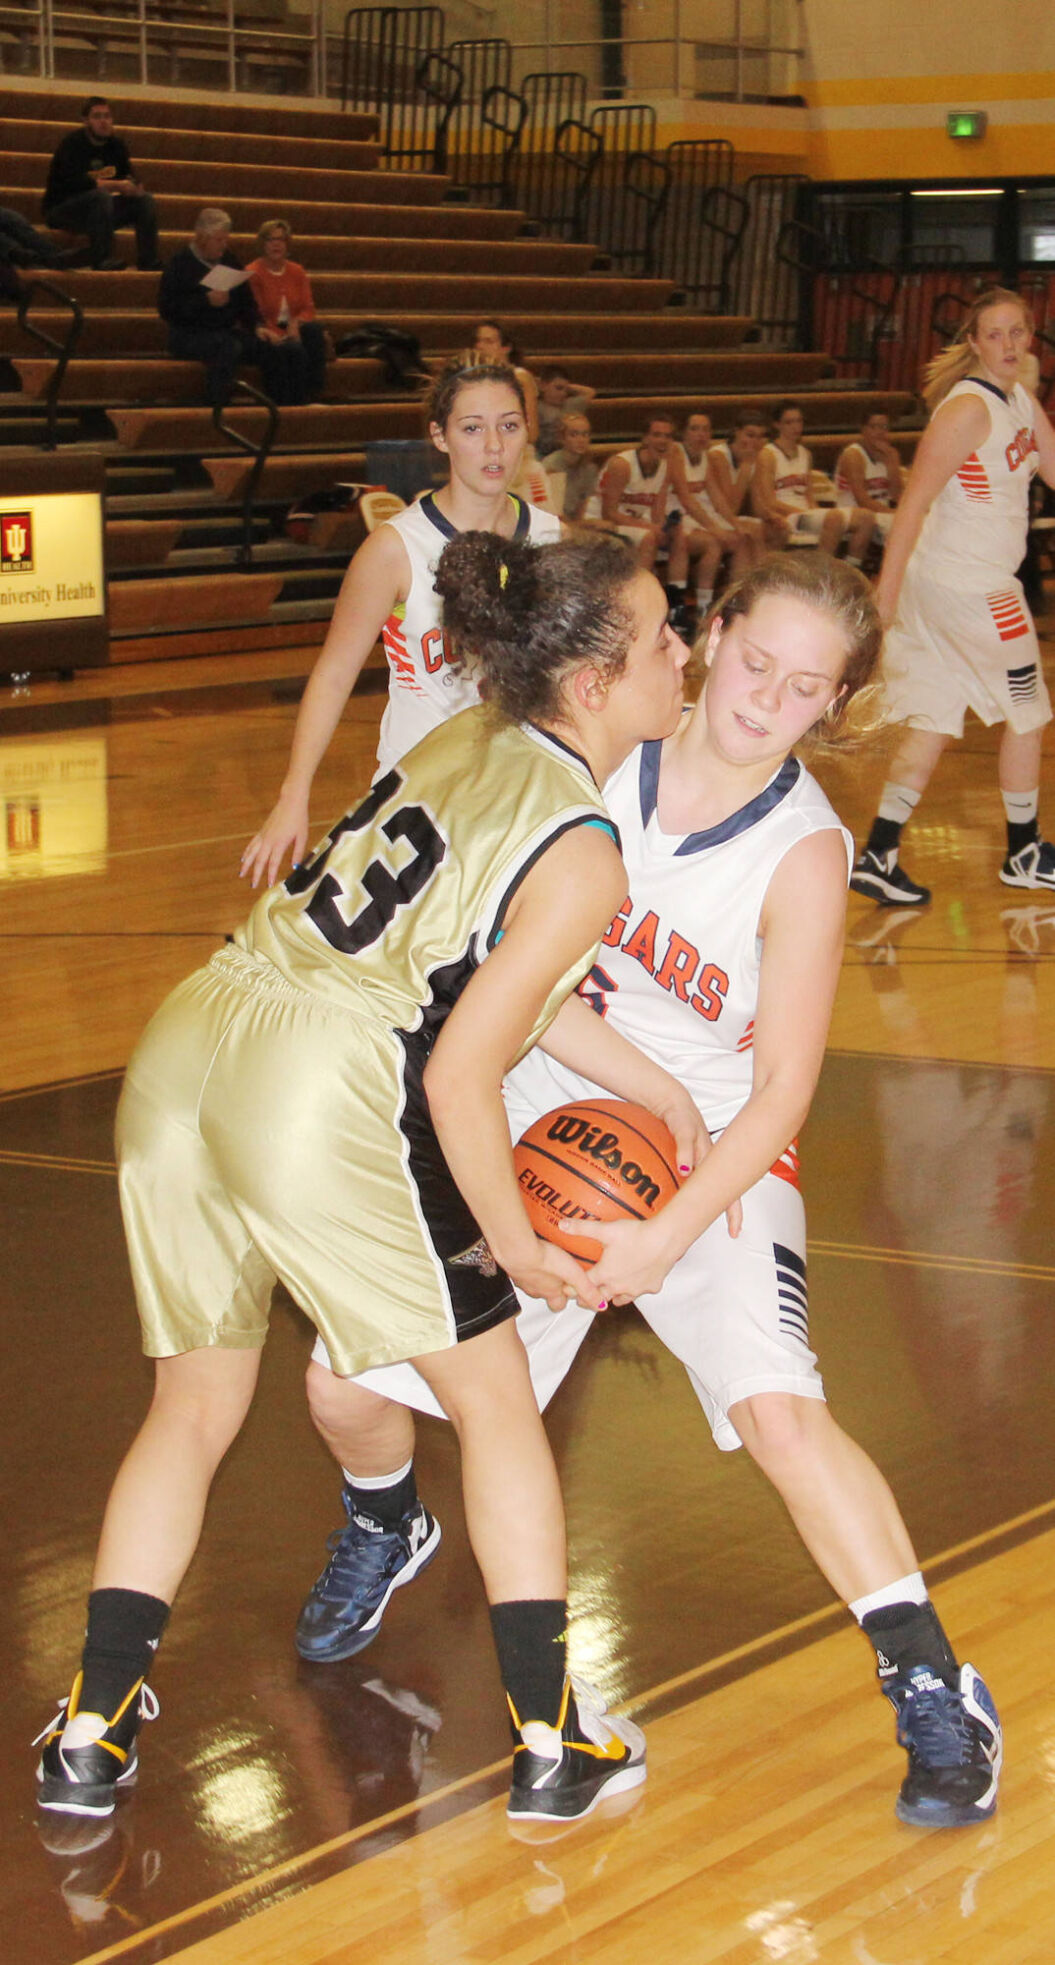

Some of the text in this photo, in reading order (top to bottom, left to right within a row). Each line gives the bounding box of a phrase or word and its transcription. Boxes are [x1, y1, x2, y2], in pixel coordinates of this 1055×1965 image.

[56, 582, 96, 602] Health
[547, 1114, 661, 1209] Wilson
[518, 1168, 602, 1221] EVOLUT
